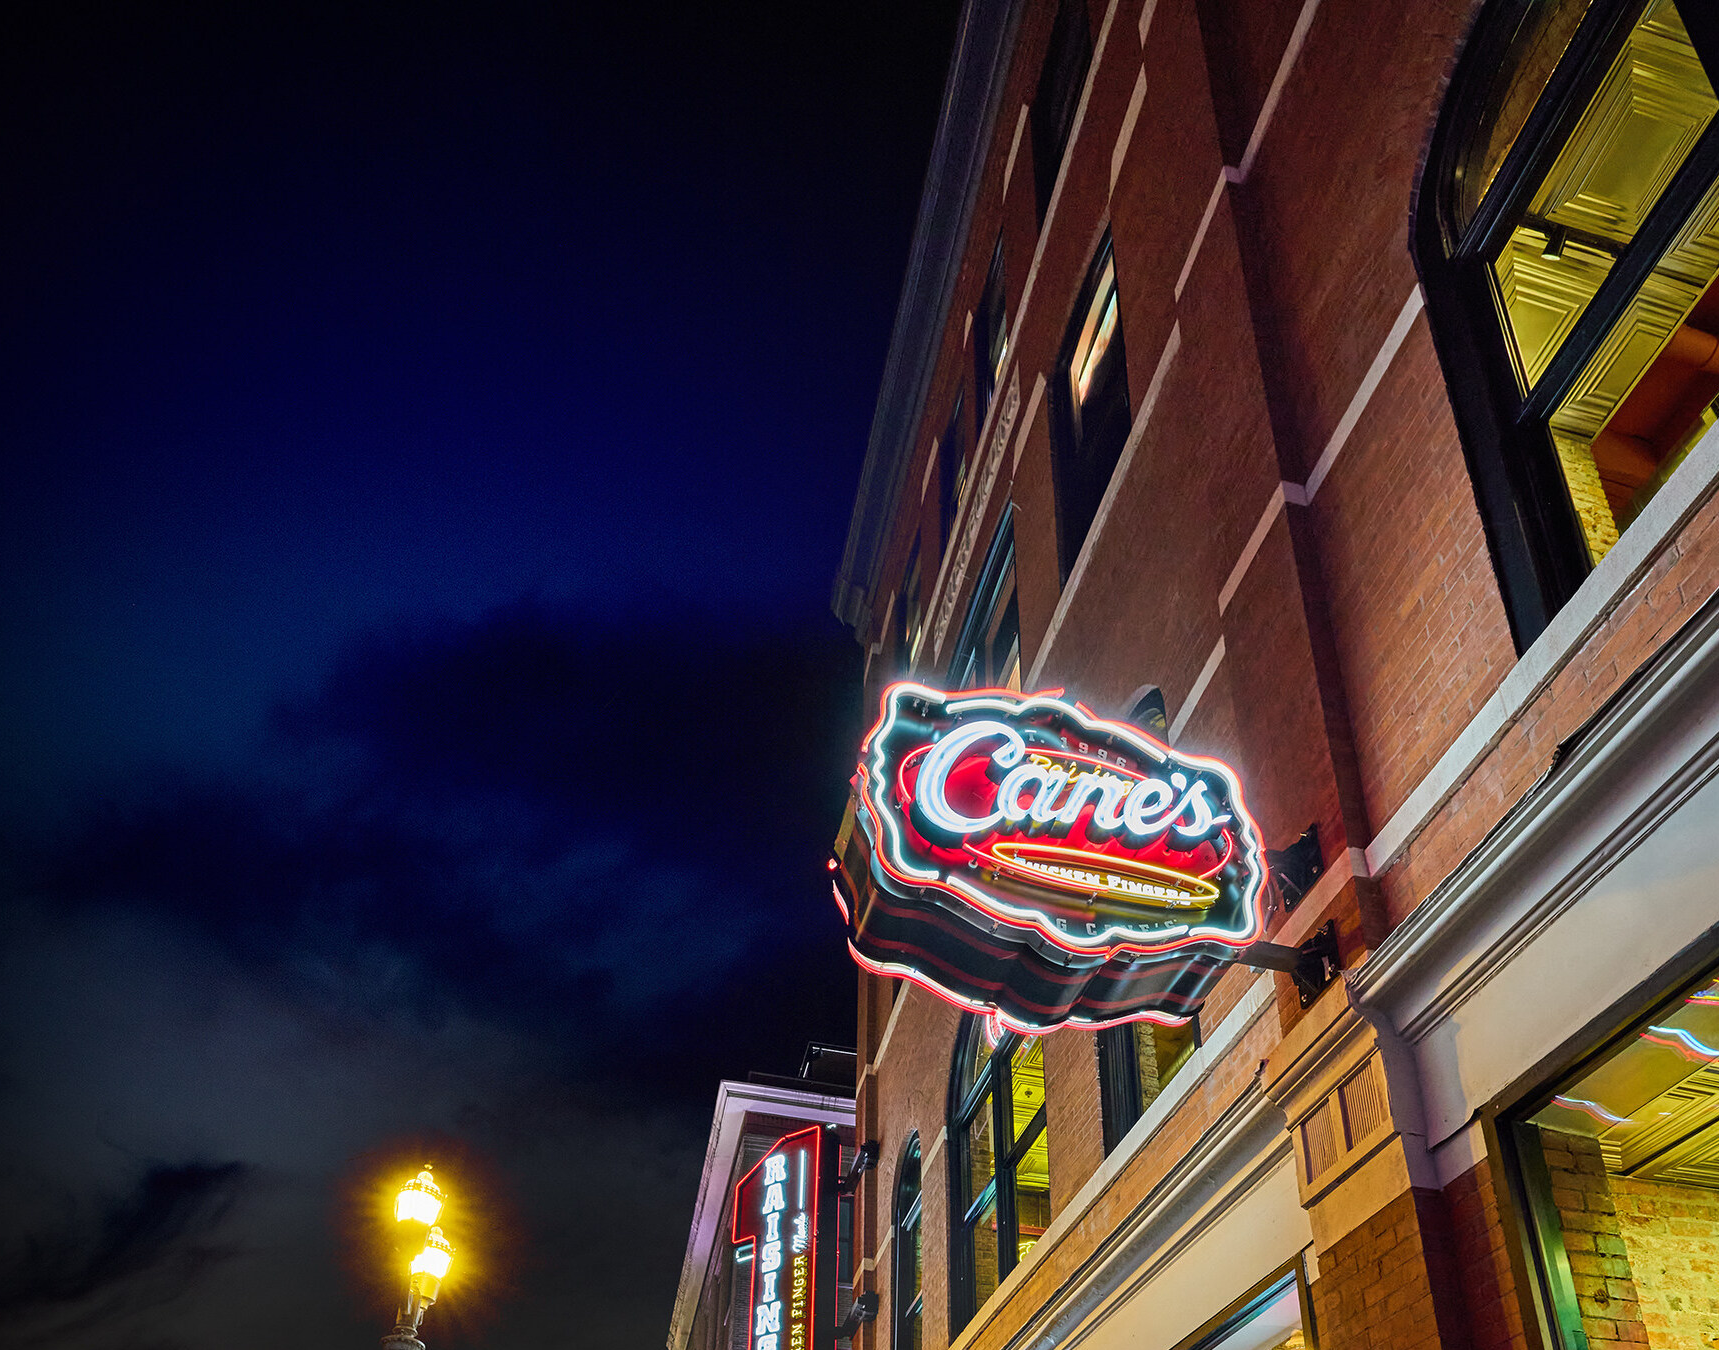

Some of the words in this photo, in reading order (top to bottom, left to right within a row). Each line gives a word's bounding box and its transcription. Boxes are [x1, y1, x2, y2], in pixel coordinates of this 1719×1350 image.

[915, 720, 1233, 837] Cane's
[792, 1211, 808, 1254] Meals
[791, 1255, 808, 1319] FINGER
